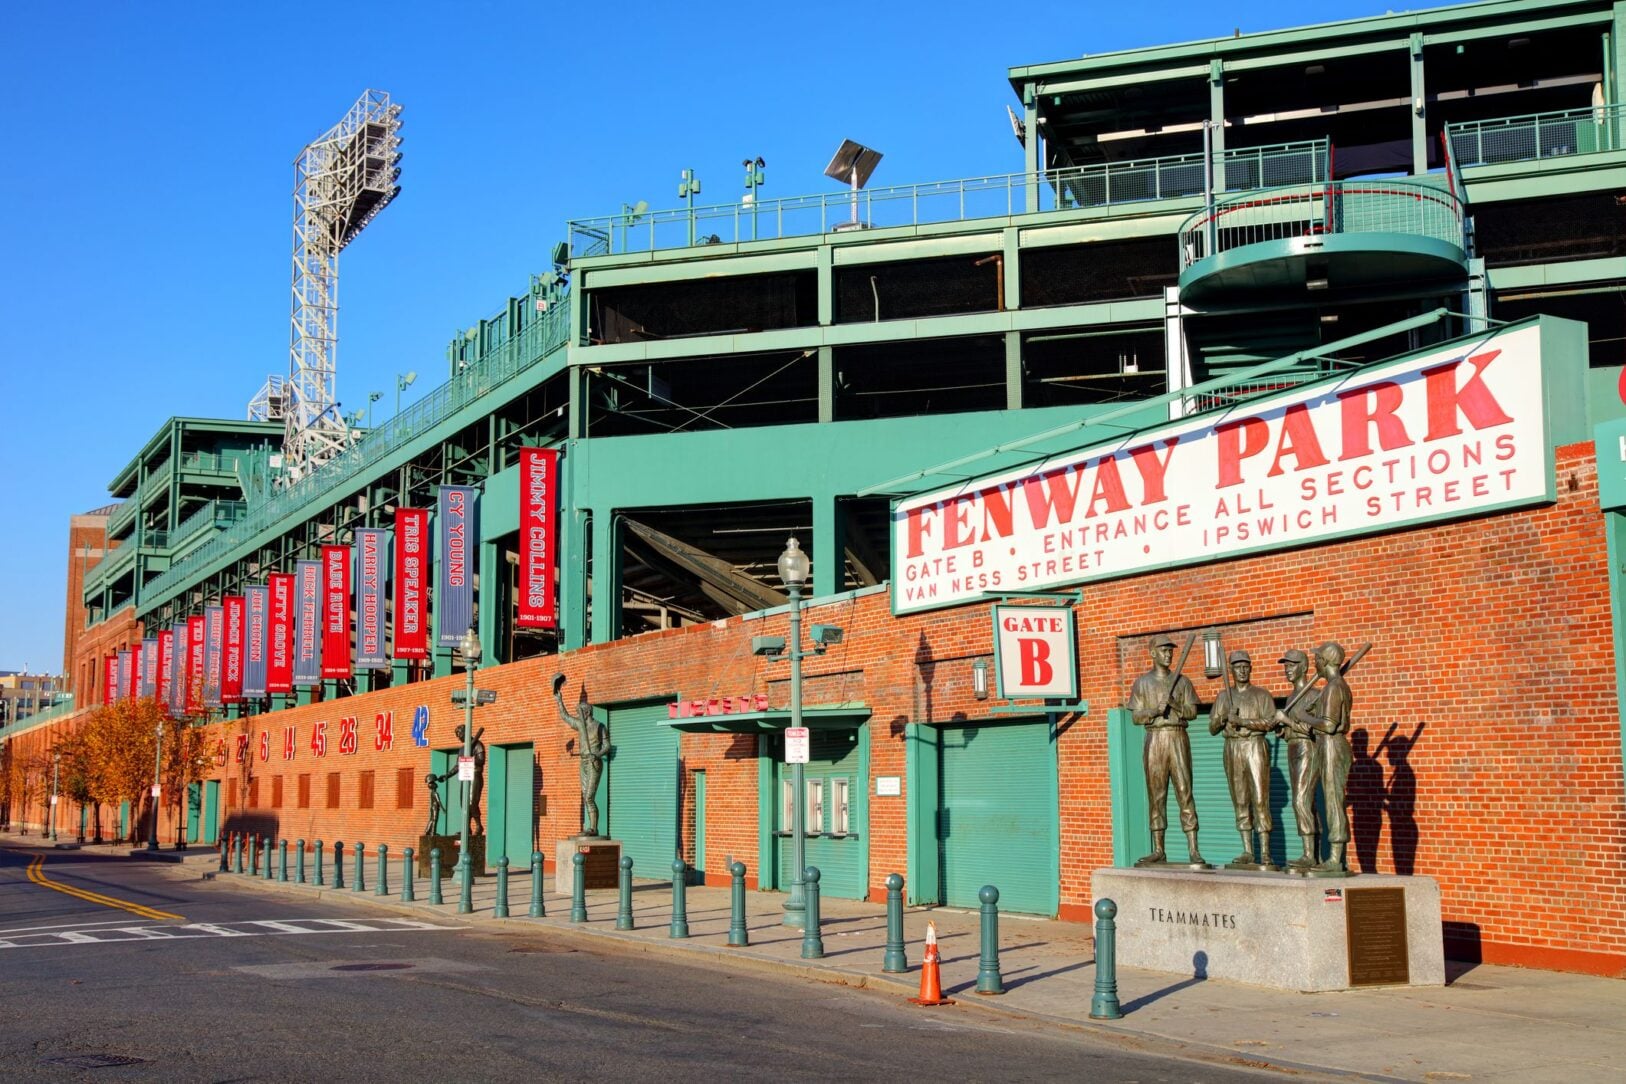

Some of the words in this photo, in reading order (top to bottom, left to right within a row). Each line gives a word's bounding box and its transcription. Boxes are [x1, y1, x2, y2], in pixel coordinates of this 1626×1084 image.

[906, 437, 1180, 559] FENWAY
[1214, 349, 1514, 489] PARK
[449, 491, 464, 518] CY
[529, 453, 546, 523] JIMMY
[906, 555, 956, 582] GATE
[973, 550, 984, 568] B
[1044, 504, 1191, 553] ENTRANCE
[1214, 488, 1273, 518] ALL
[1300, 434, 1517, 501] SECTIONS
[404, 514, 419, 553] TRIS
[906, 583, 937, 602] VAN
[952, 570, 1001, 593] NESS
[1018, 550, 1104, 581] STREET
[1203, 504, 1337, 547] IPSWICH
[1366, 468, 1517, 517] STREET
[329, 551, 342, 590] BABE
[364, 534, 376, 589] HARRY
[449, 524, 465, 587] YOUNG
[528, 527, 545, 608] COLLINS
[252, 589, 263, 613] JOE
[275, 577, 287, 621] LEFTY
[304, 566, 316, 598] RICK
[403, 556, 419, 634] SPEAKER
[329, 593, 343, 633] RUTH
[364, 594, 376, 654] HOOPER
[520, 614, 552, 622] 1901-1907
[1003, 617, 1063, 632] GATE
[250, 614, 262, 662] CRONIN
[274, 623, 286, 668] GROVE
[228, 646, 240, 682] FOXX
[1017, 638, 1053, 686] B
[411, 704, 431, 748] 42
[666, 694, 769, 719] TICKETS
[235, 733, 249, 763] 27
[260, 730, 269, 762] 6
[283, 726, 296, 760] 14
[310, 721, 327, 758] 45
[338, 716, 358, 755] 26
[374, 710, 394, 752] 34
[1149, 907, 1236, 930] TEAMMATES
